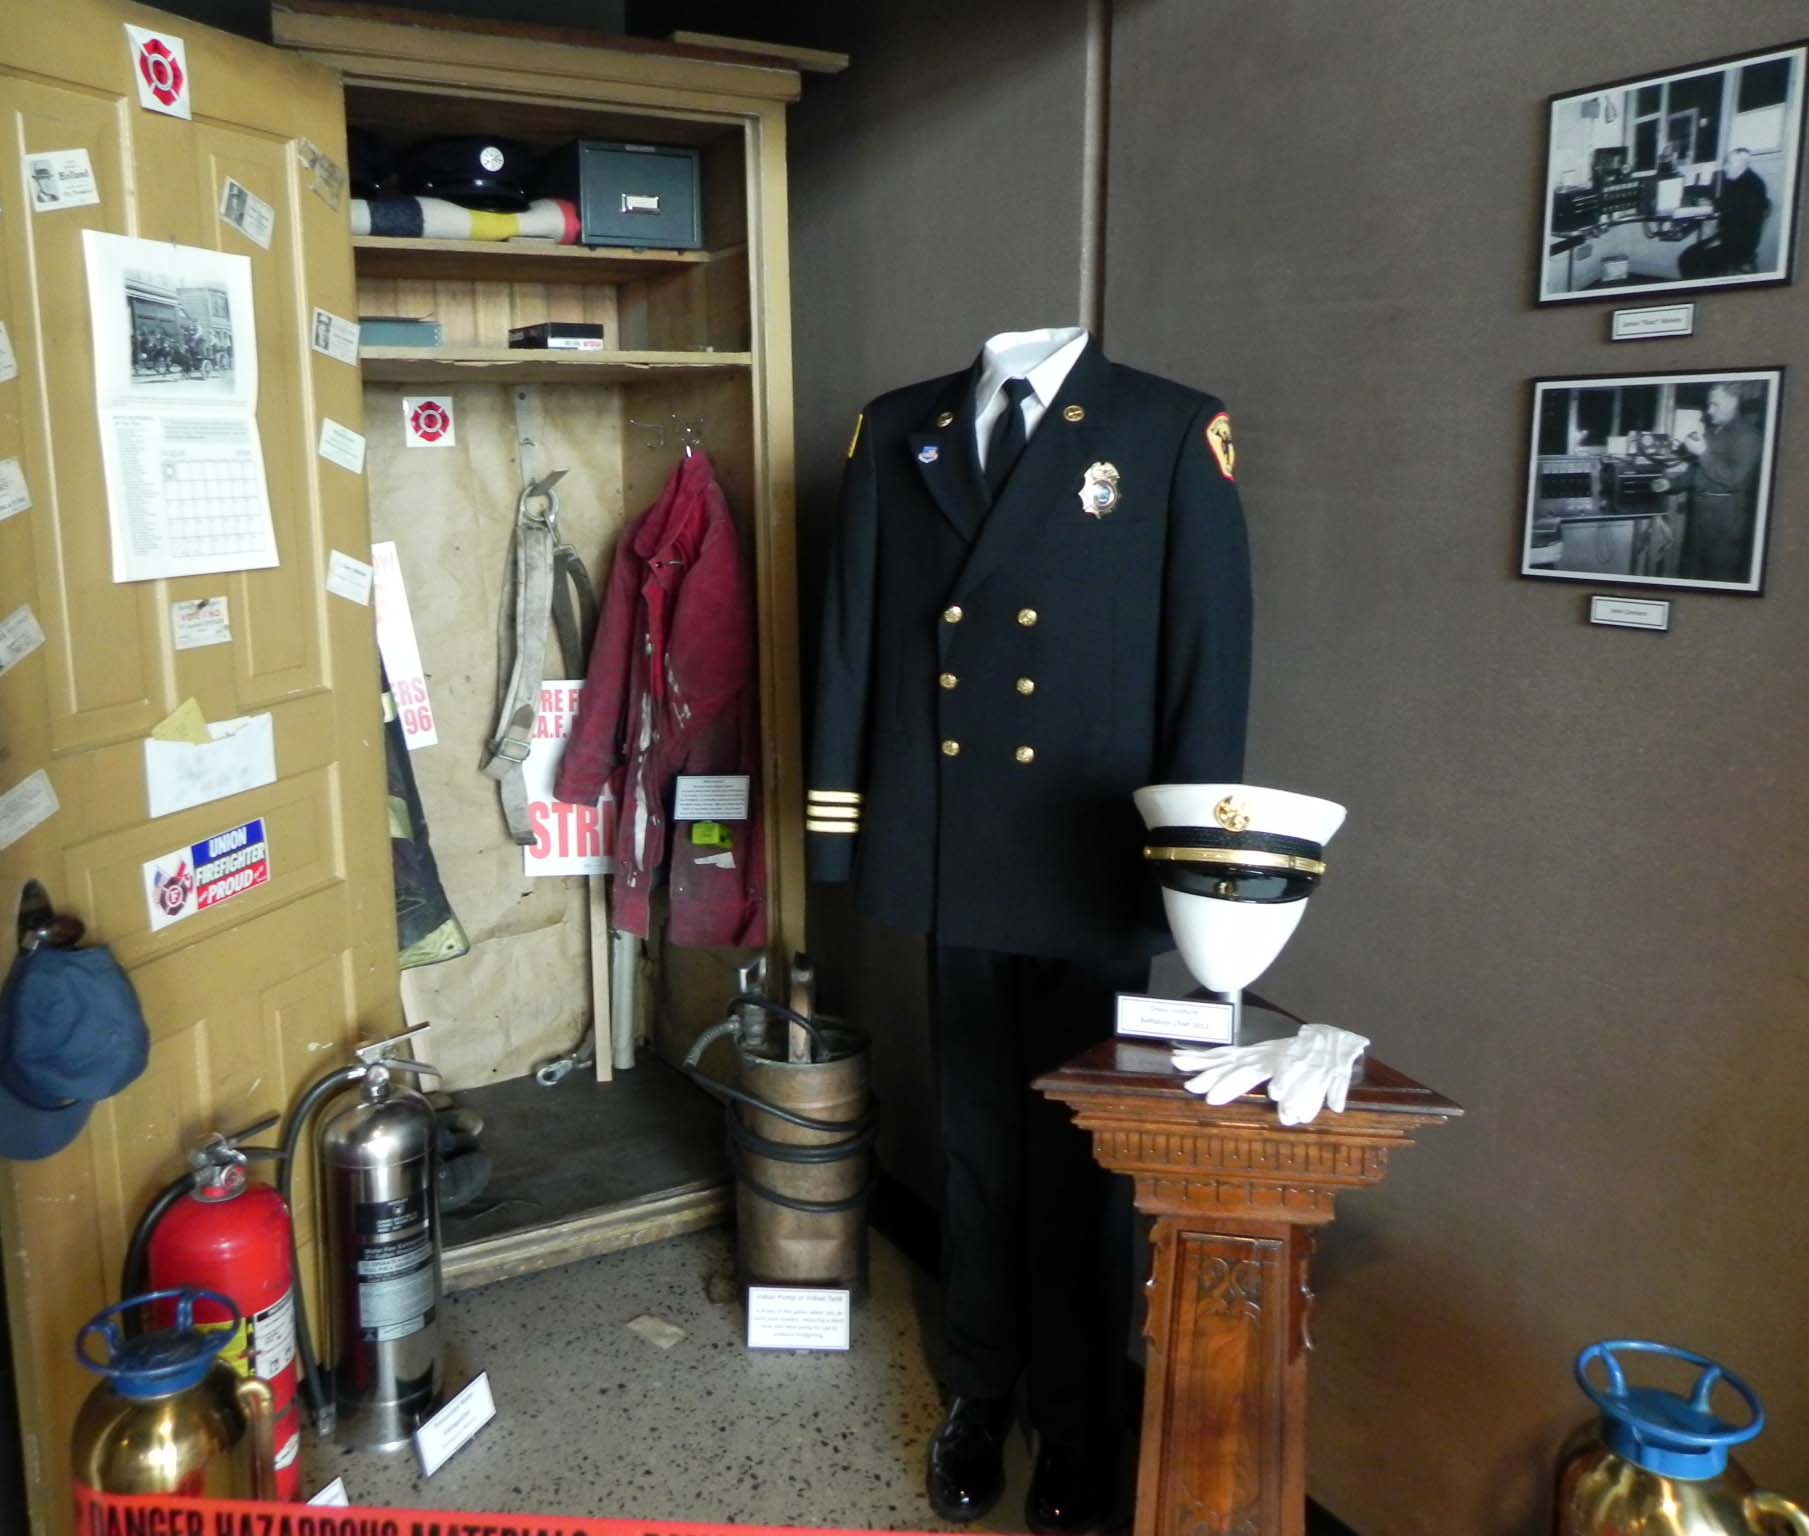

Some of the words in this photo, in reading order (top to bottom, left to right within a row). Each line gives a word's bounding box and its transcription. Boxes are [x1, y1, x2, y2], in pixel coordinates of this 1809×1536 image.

[403, 705, 432, 735] 96
[208, 826, 247, 858] UNION
[196, 843, 267, 886] FIREFIGHTER
[206, 868, 254, 904] PROUD
[90, 1501, 203, 1536] DANGER
